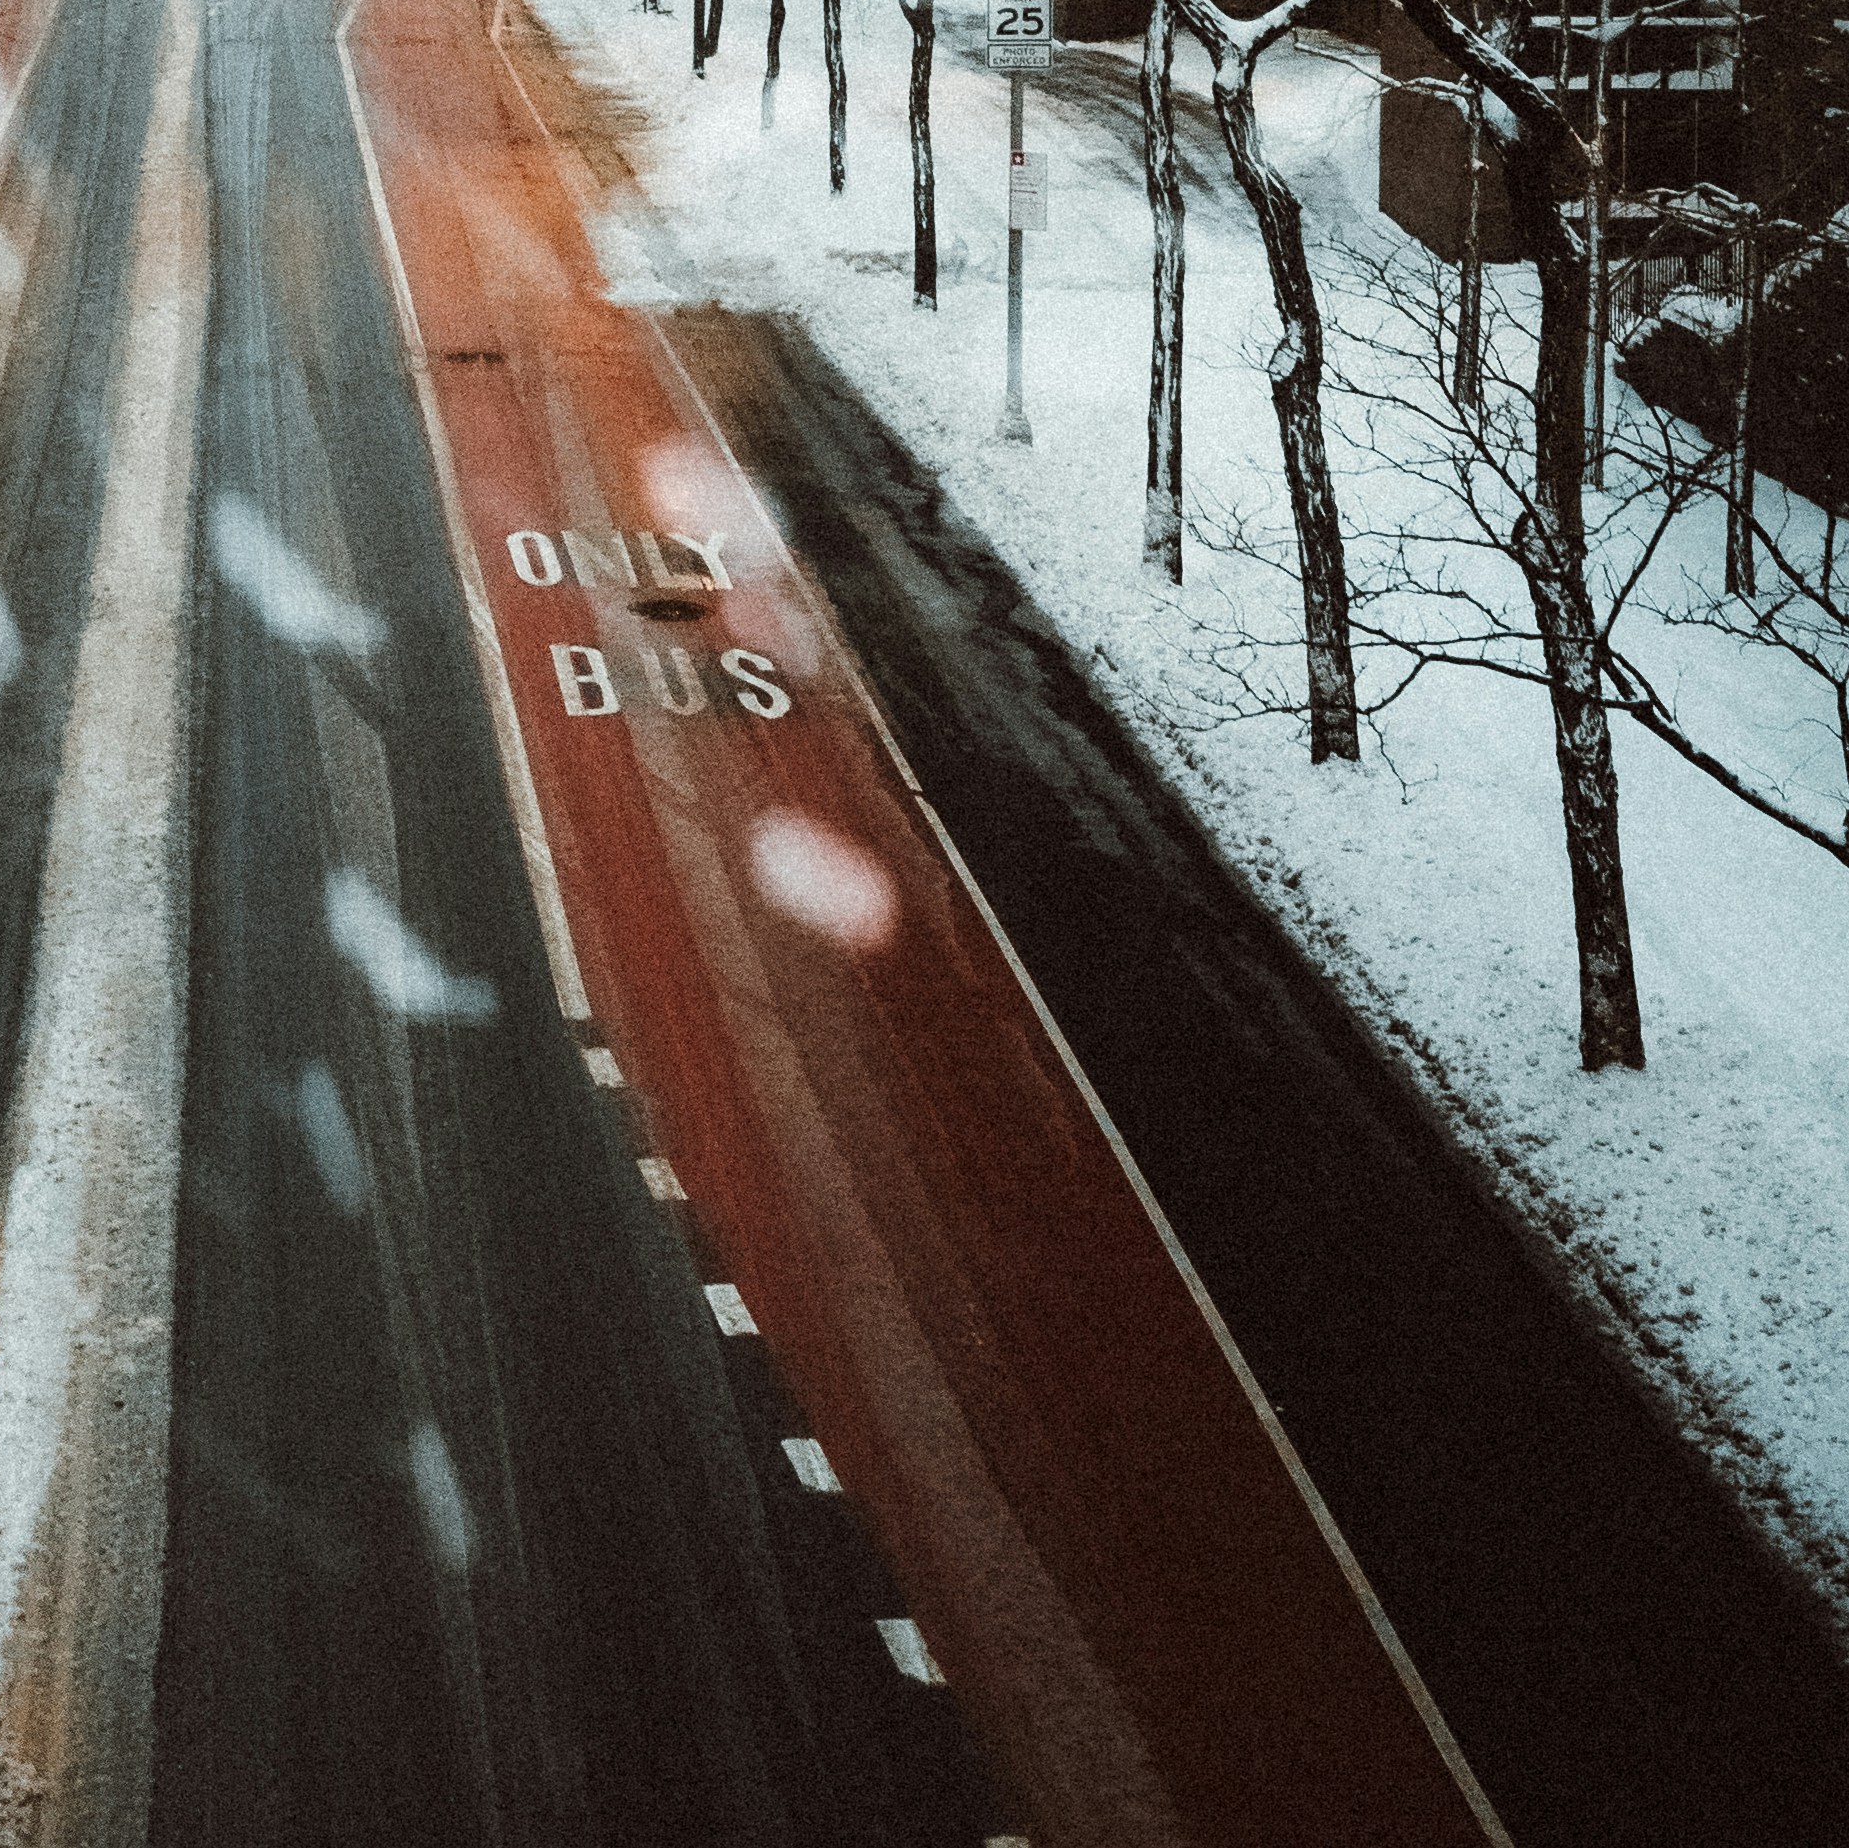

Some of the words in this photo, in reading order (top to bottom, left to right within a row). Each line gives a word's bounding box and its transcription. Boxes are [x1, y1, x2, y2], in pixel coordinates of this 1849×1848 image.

[996, 7, 1044, 35] 25
[993, 57, 1046, 66] ENFORCED
[1003, 48, 1036, 56] PHOTO
[505, 529, 734, 591] ONLY
[549, 643, 792, 720] BUS
